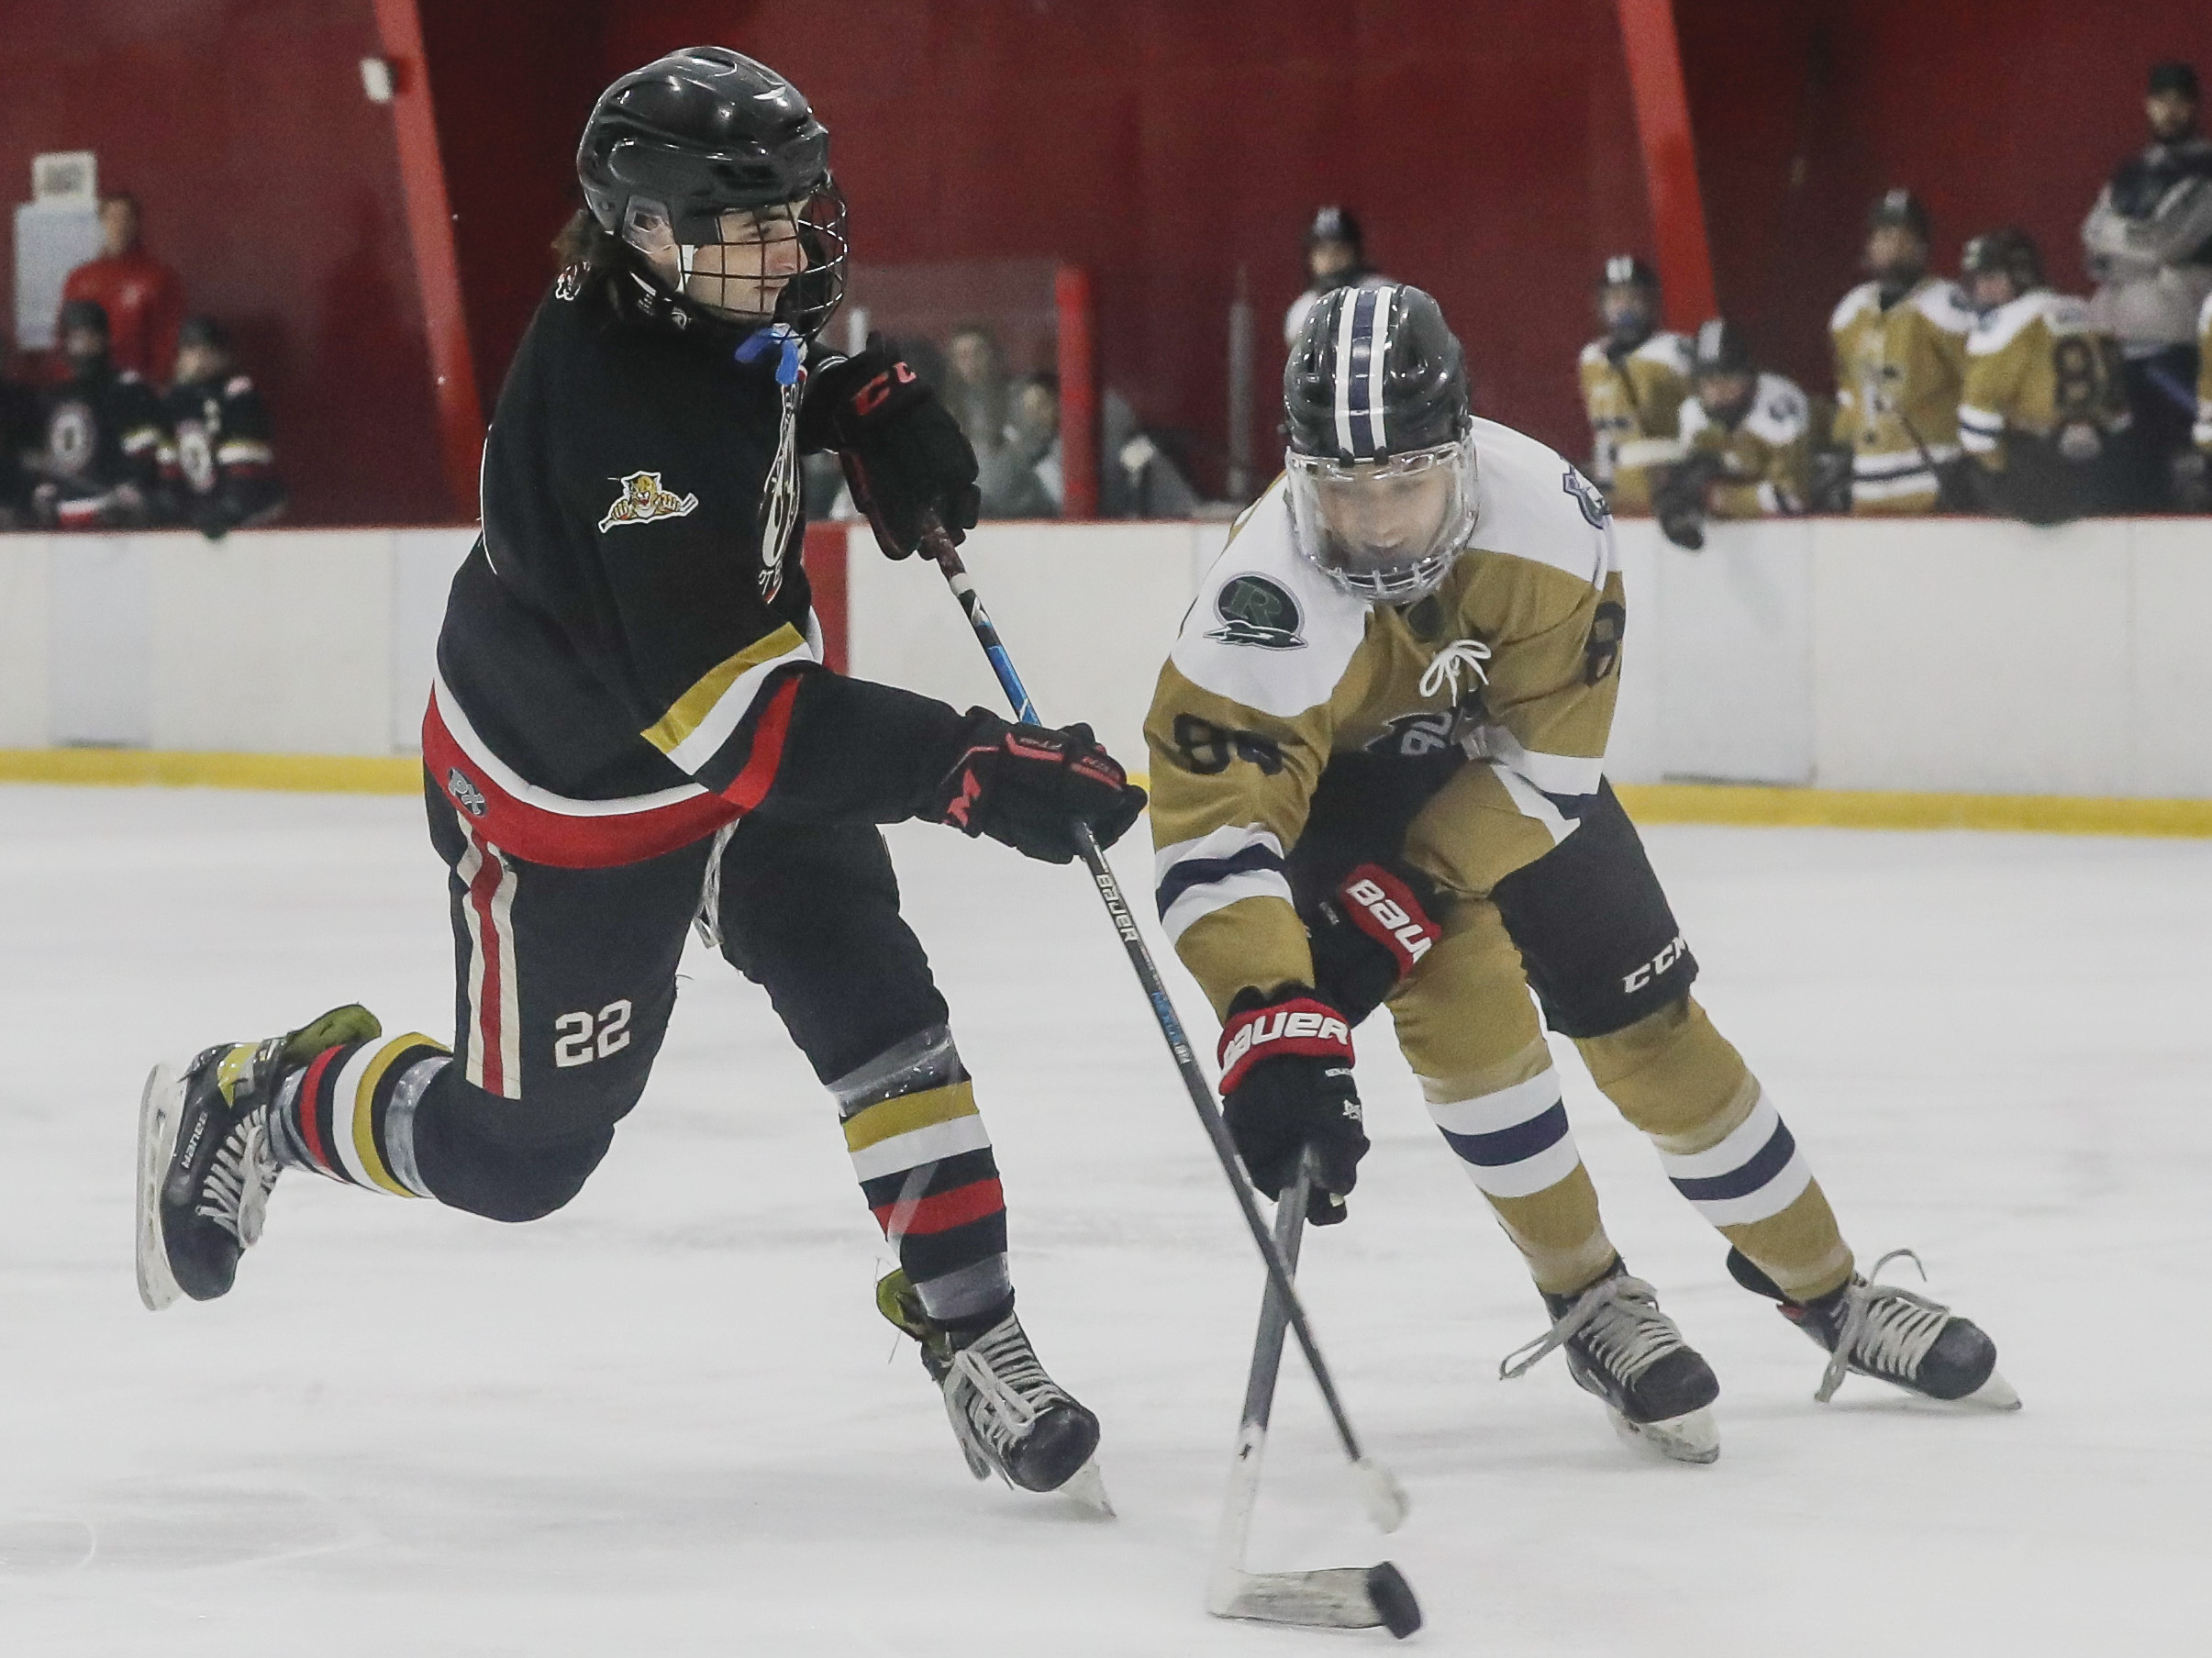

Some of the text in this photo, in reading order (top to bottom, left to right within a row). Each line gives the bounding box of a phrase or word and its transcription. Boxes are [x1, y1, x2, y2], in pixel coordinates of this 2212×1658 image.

[1583, 600, 1627, 688] 8
[1095, 874, 1139, 943] BAUER
[1345, 877, 1433, 964] BAU
[554, 998, 632, 1068] 22
